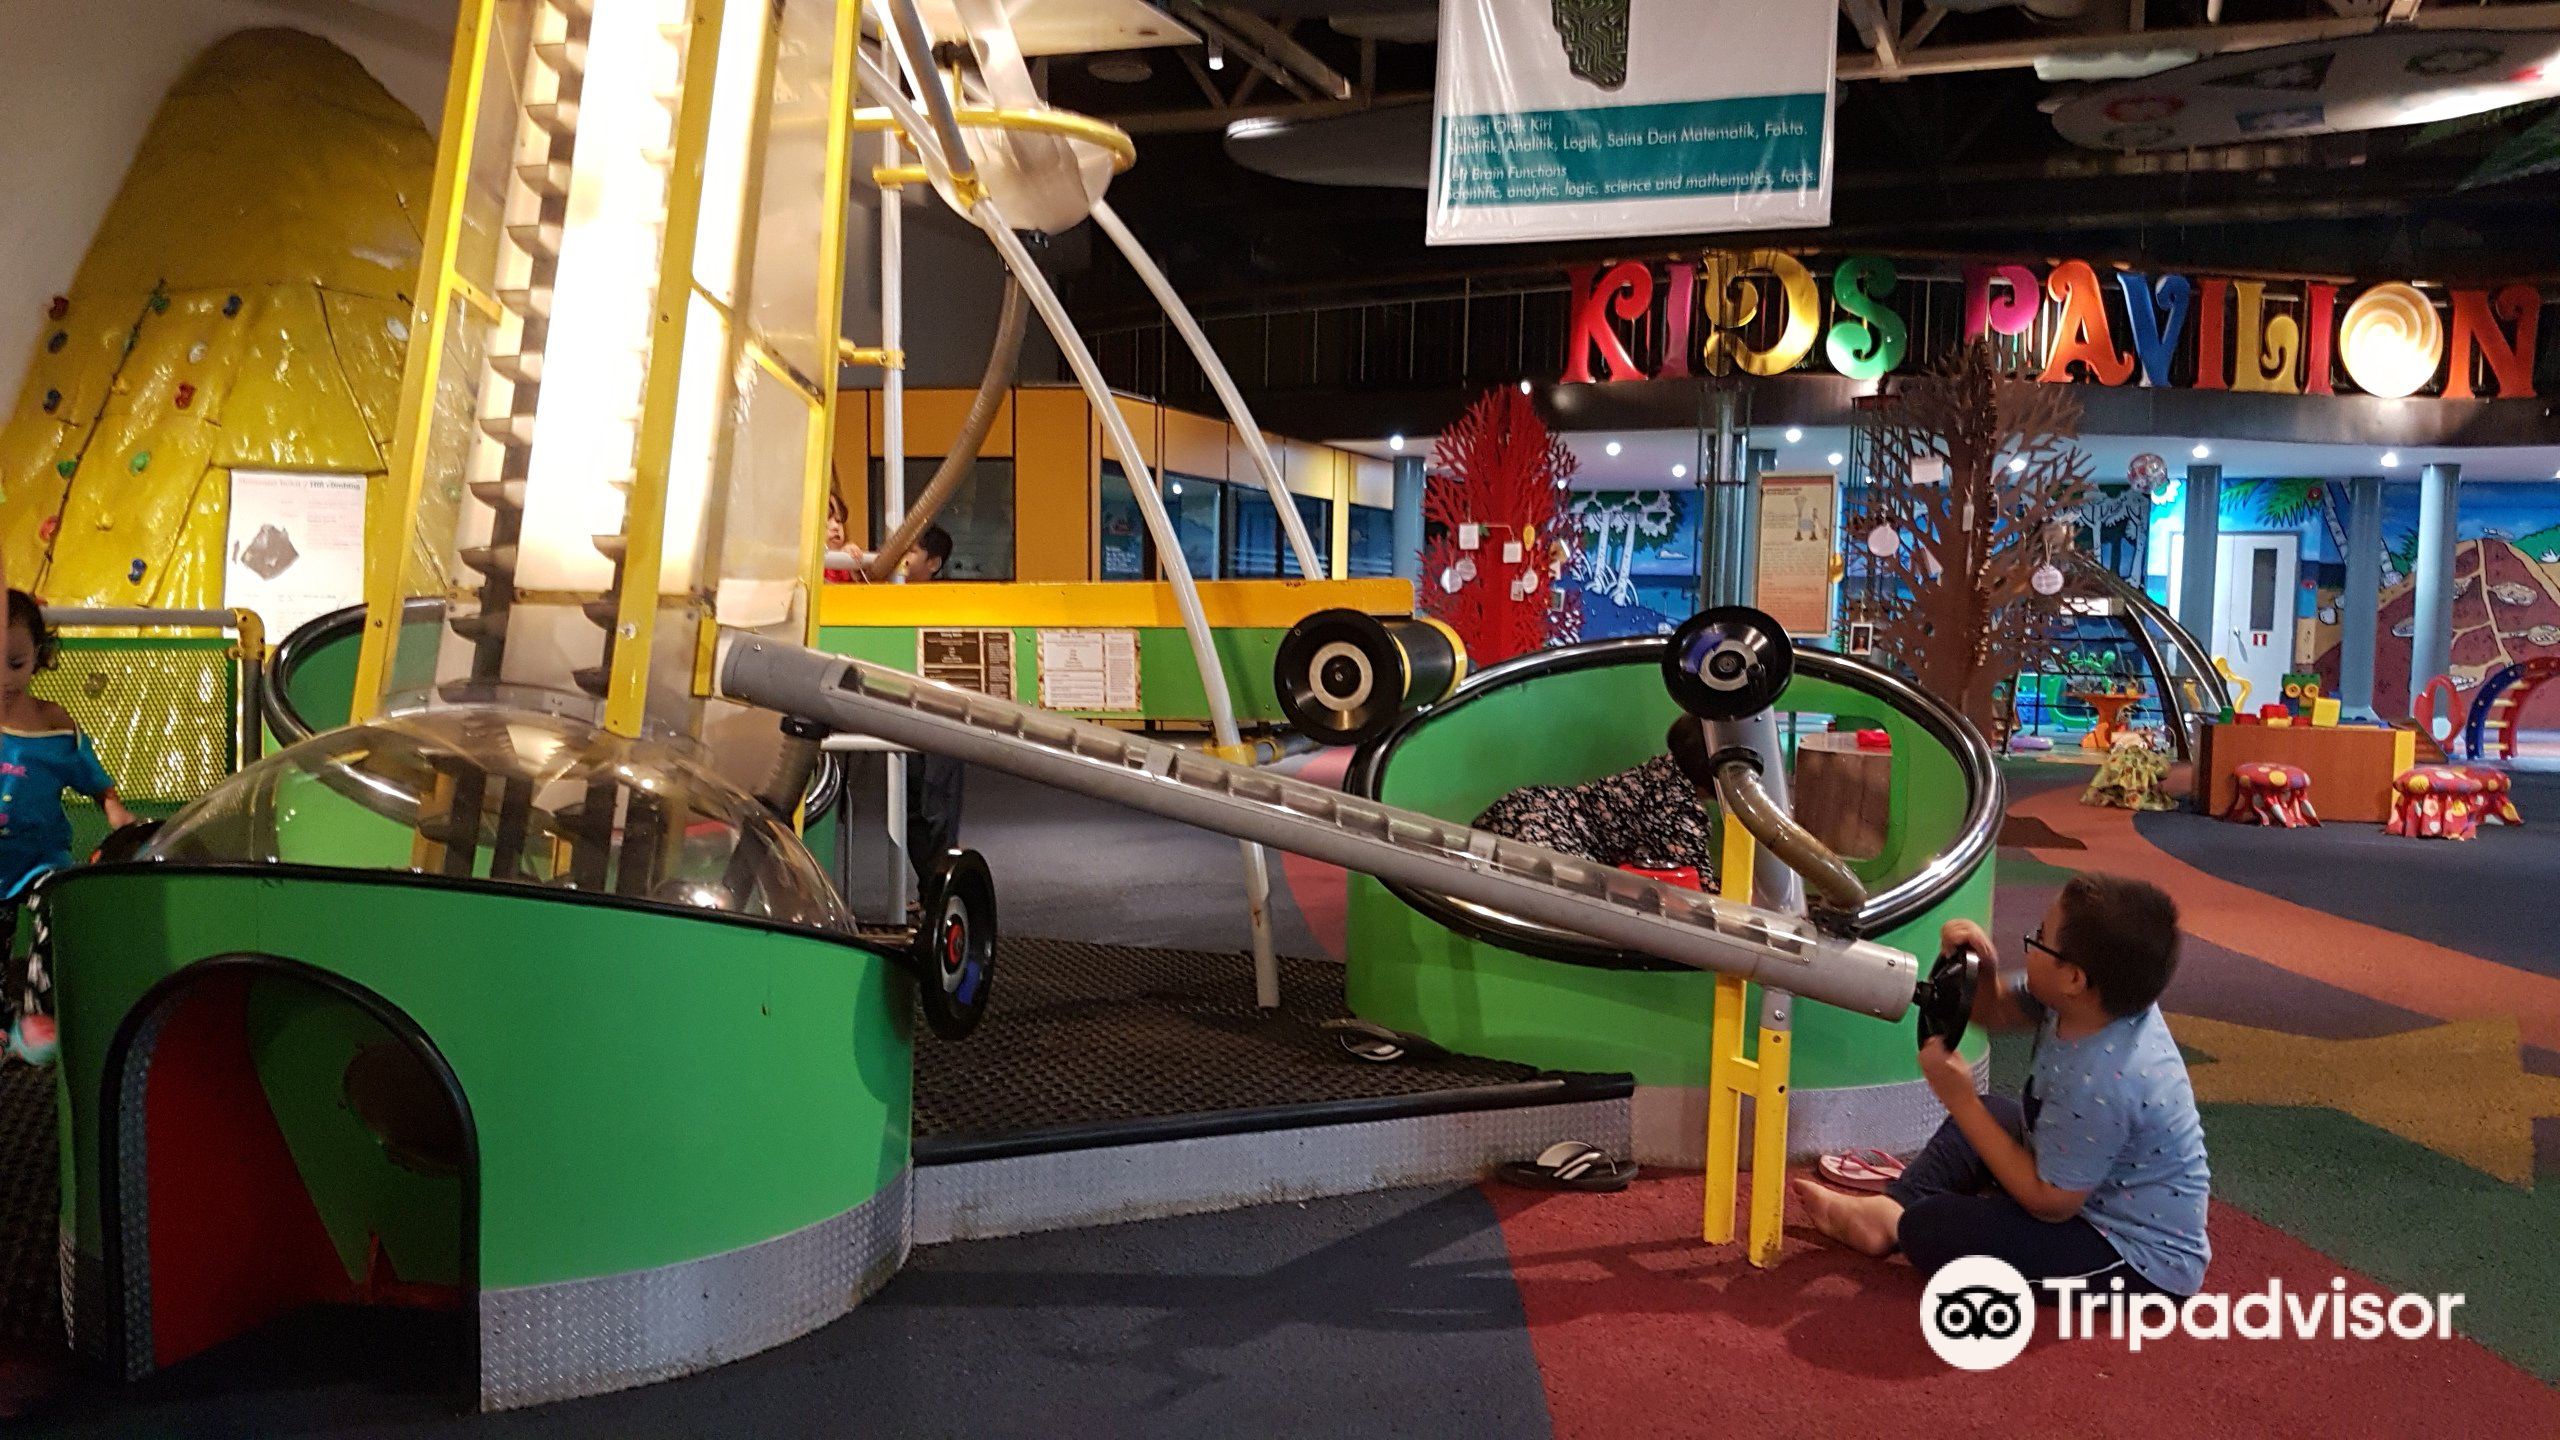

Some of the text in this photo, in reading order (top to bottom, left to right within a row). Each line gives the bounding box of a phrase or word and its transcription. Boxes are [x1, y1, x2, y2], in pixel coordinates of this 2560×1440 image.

[1531, 118, 1553, 131] Kiri
[1563, 133, 1602, 152] Logik,
[1607, 132, 1643, 147] Sains
[1647, 129, 1677, 144] Dan
[1681, 123, 1760, 141] Matematik,
[1449, 164, 1568, 182] eft Brain Functions
[1507, 182, 1560, 199] analytic,
[1564, 179, 1600, 197] logic,
[1604, 179, 1652, 193] science
[1655, 175, 1682, 190] and
[1686, 171, 1775, 189] mathematics,
[1559, 248, 2542, 400] KIDS PAVILION
